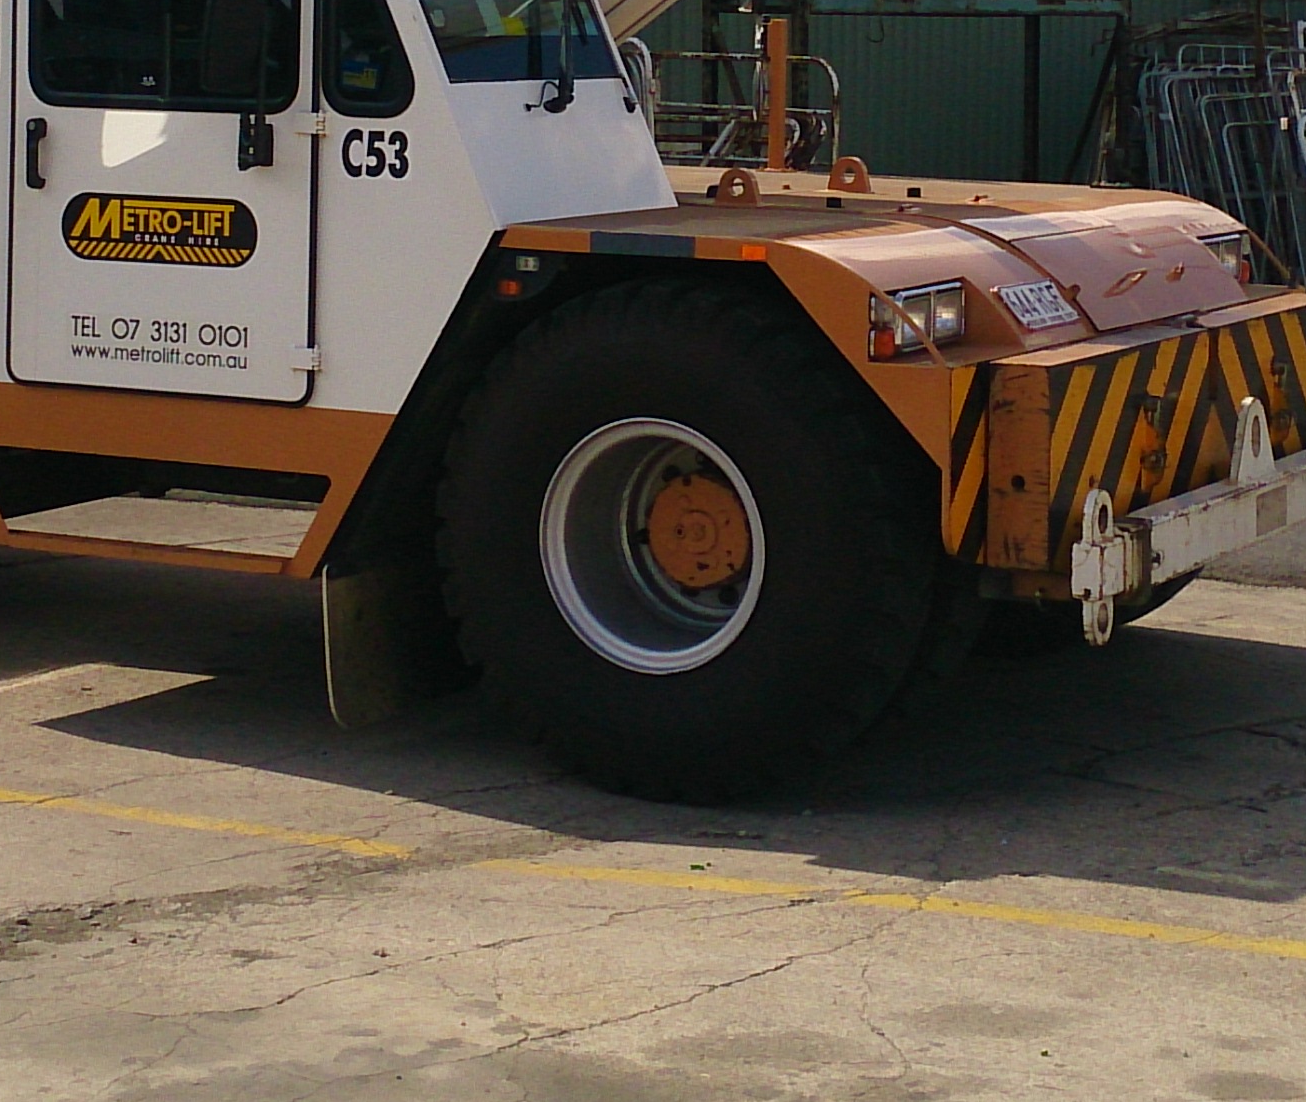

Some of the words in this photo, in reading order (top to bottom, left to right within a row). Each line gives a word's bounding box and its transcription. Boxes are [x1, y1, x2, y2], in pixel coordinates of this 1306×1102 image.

[342, 129, 409, 179] C53
[70, 198, 235, 239] METRO-LIFT
[71, 315, 101, 338] TEL
[111, 318, 140, 340] 07
[150, 320, 187, 344] 3131
[198, 323, 249, 348] 0101
[71, 344, 248, 370] www.metrolift.com.au
